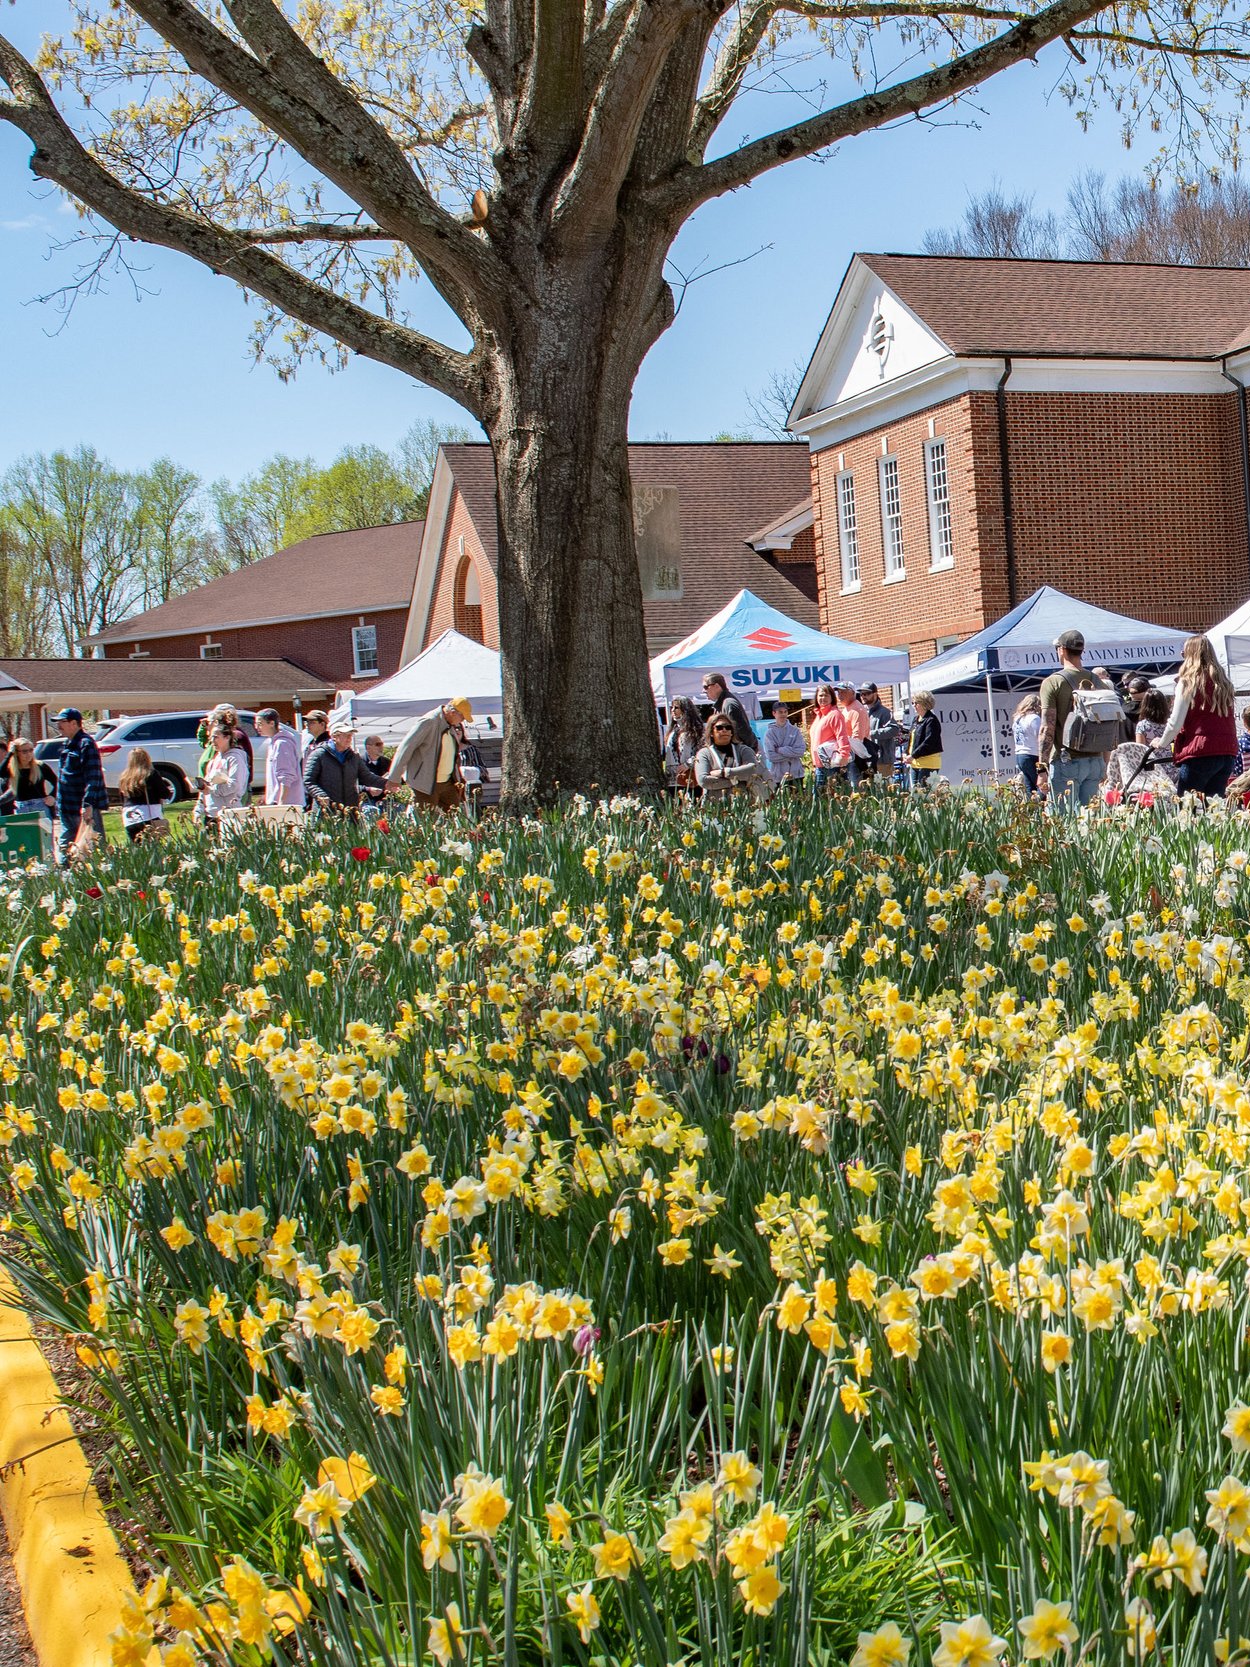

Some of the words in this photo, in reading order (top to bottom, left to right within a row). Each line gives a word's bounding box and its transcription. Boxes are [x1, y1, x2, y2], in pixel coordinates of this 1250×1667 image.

[1025, 652, 1060, 665] LOYAL
[1124, 645, 1176, 659] SERVICES
[732, 665, 840, 687] SUZUKI
